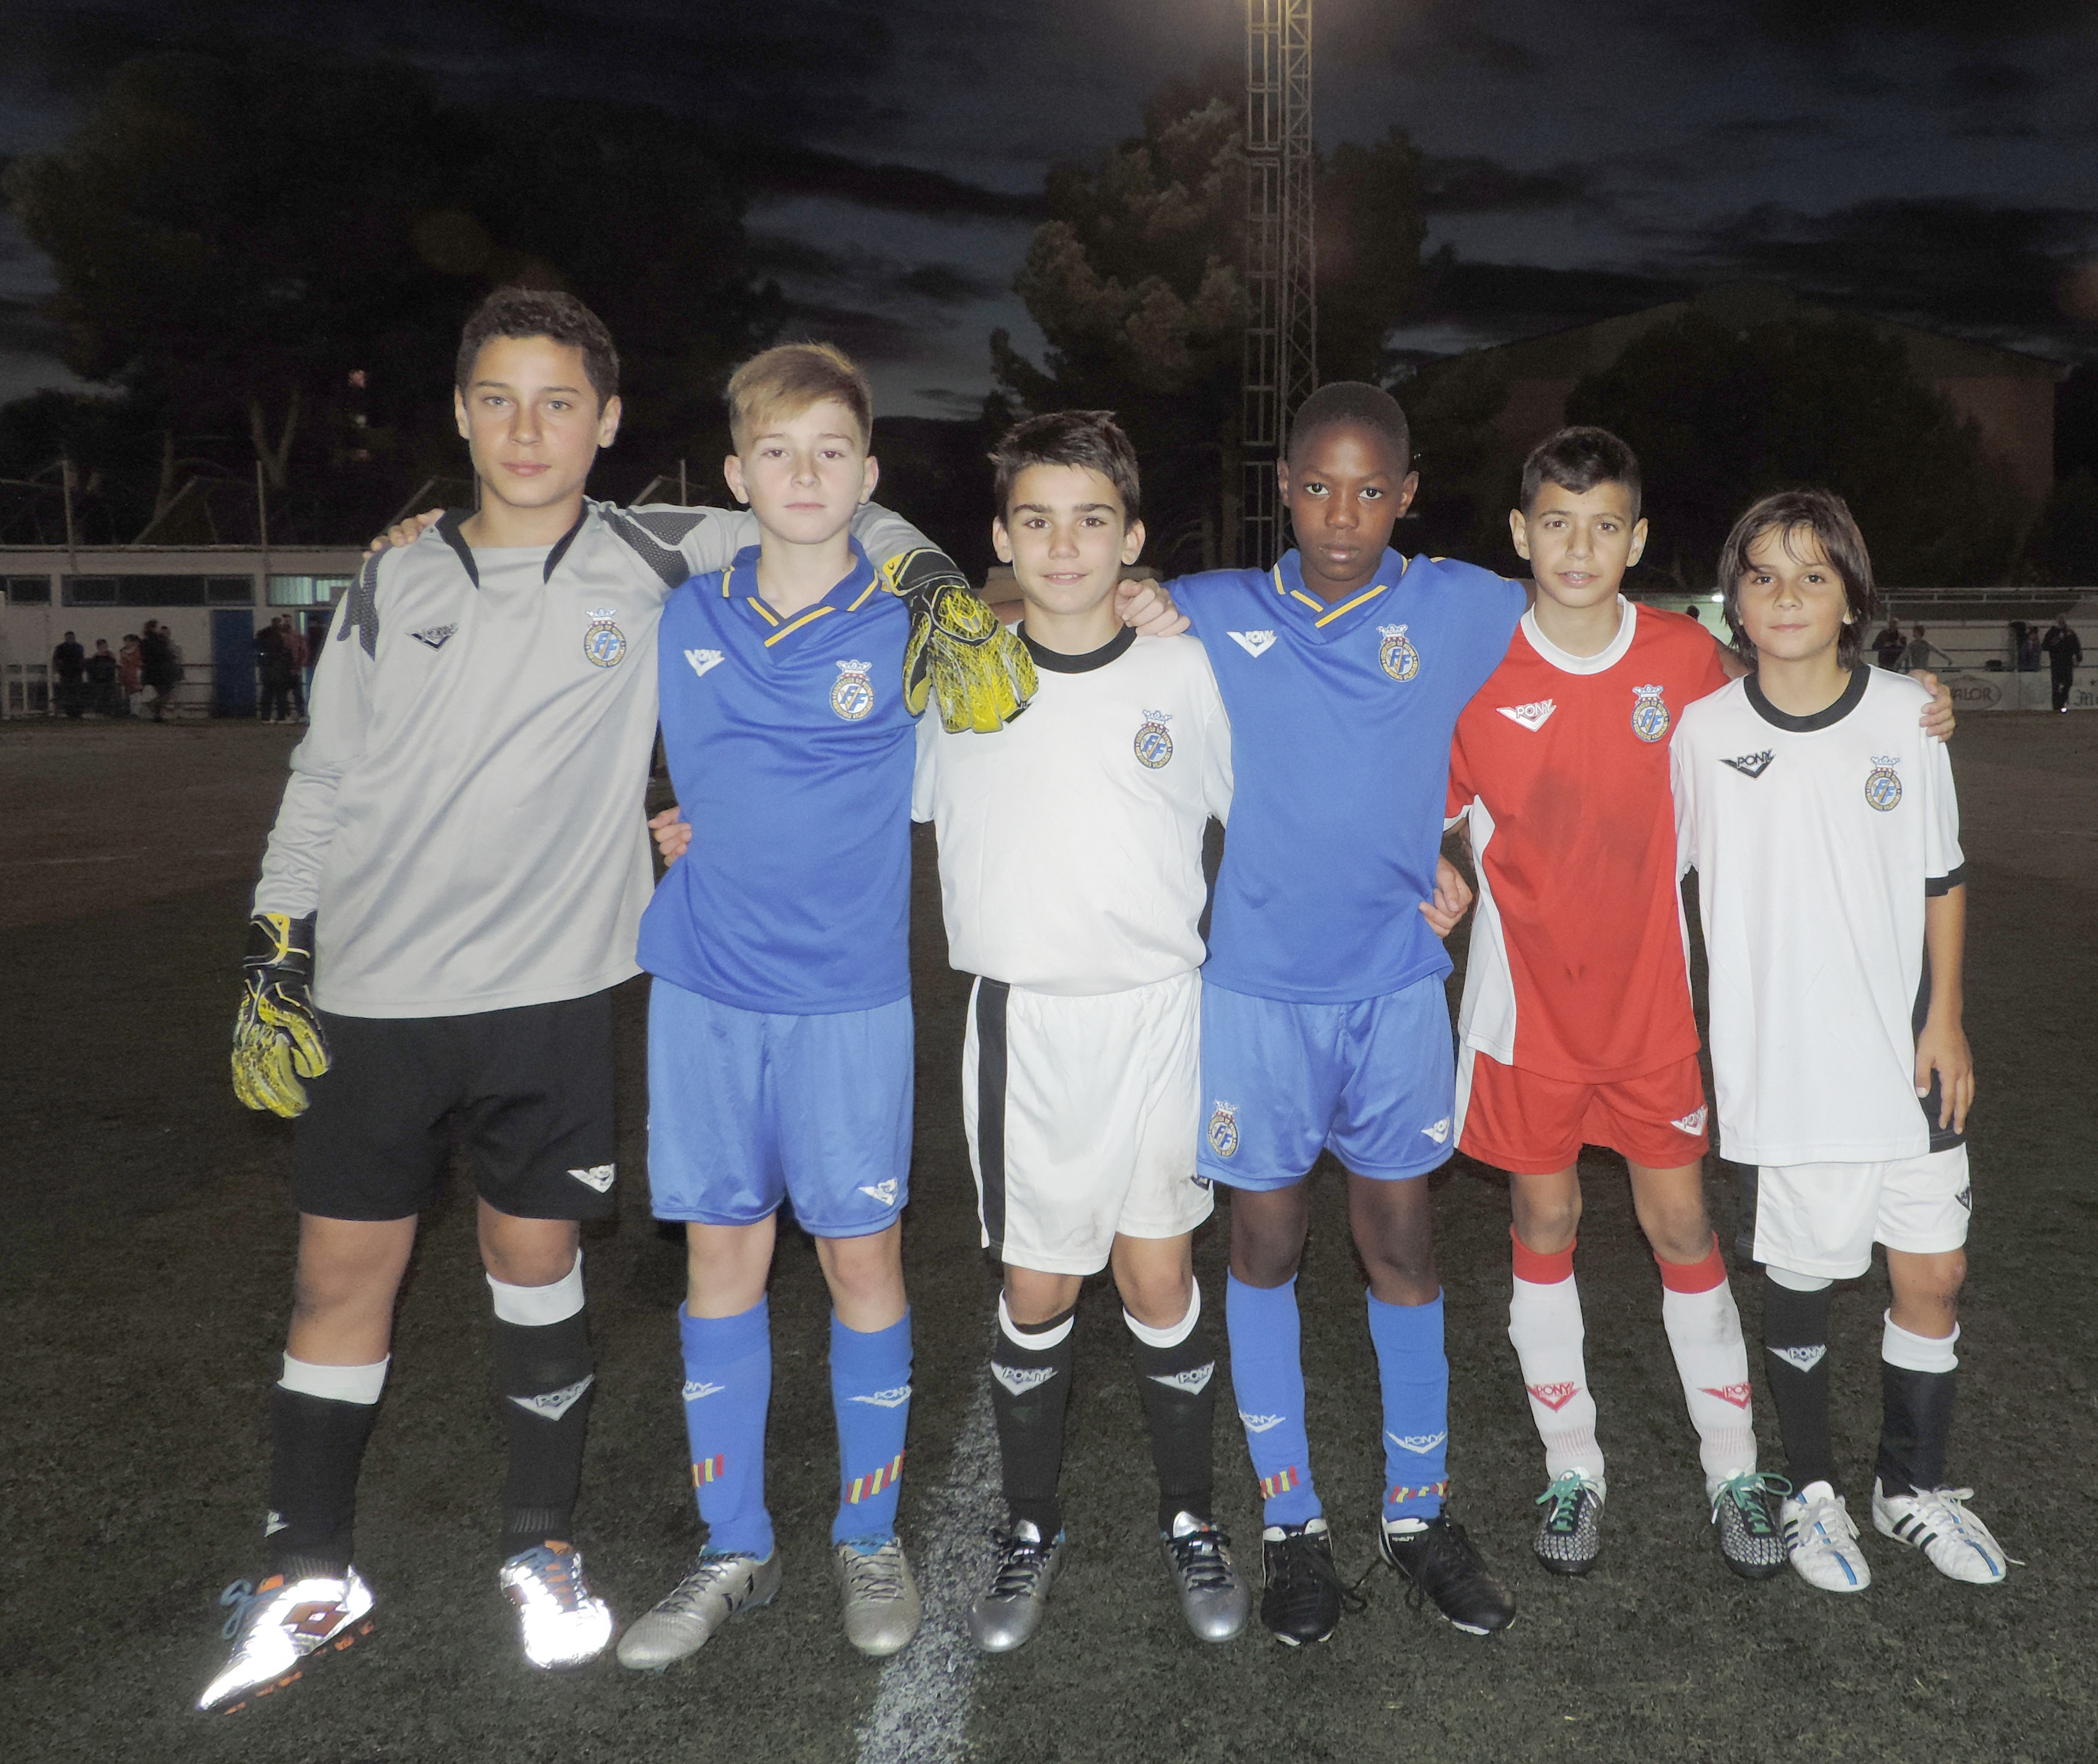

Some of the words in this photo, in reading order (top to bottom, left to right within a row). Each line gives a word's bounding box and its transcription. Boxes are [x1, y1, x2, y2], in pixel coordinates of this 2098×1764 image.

[1246, 630, 1274, 643] PONY
[1516, 698, 1553, 719] PONY
[1737, 748, 1773, 767] PONY
[1791, 1345, 1825, 1359] PONY
[1005, 1367, 1053, 1383] PONY
[1535, 1382, 1574, 1397] PONY
[1724, 1383, 1749, 1399] PON
[1405, 1430, 1443, 1445] PONY
